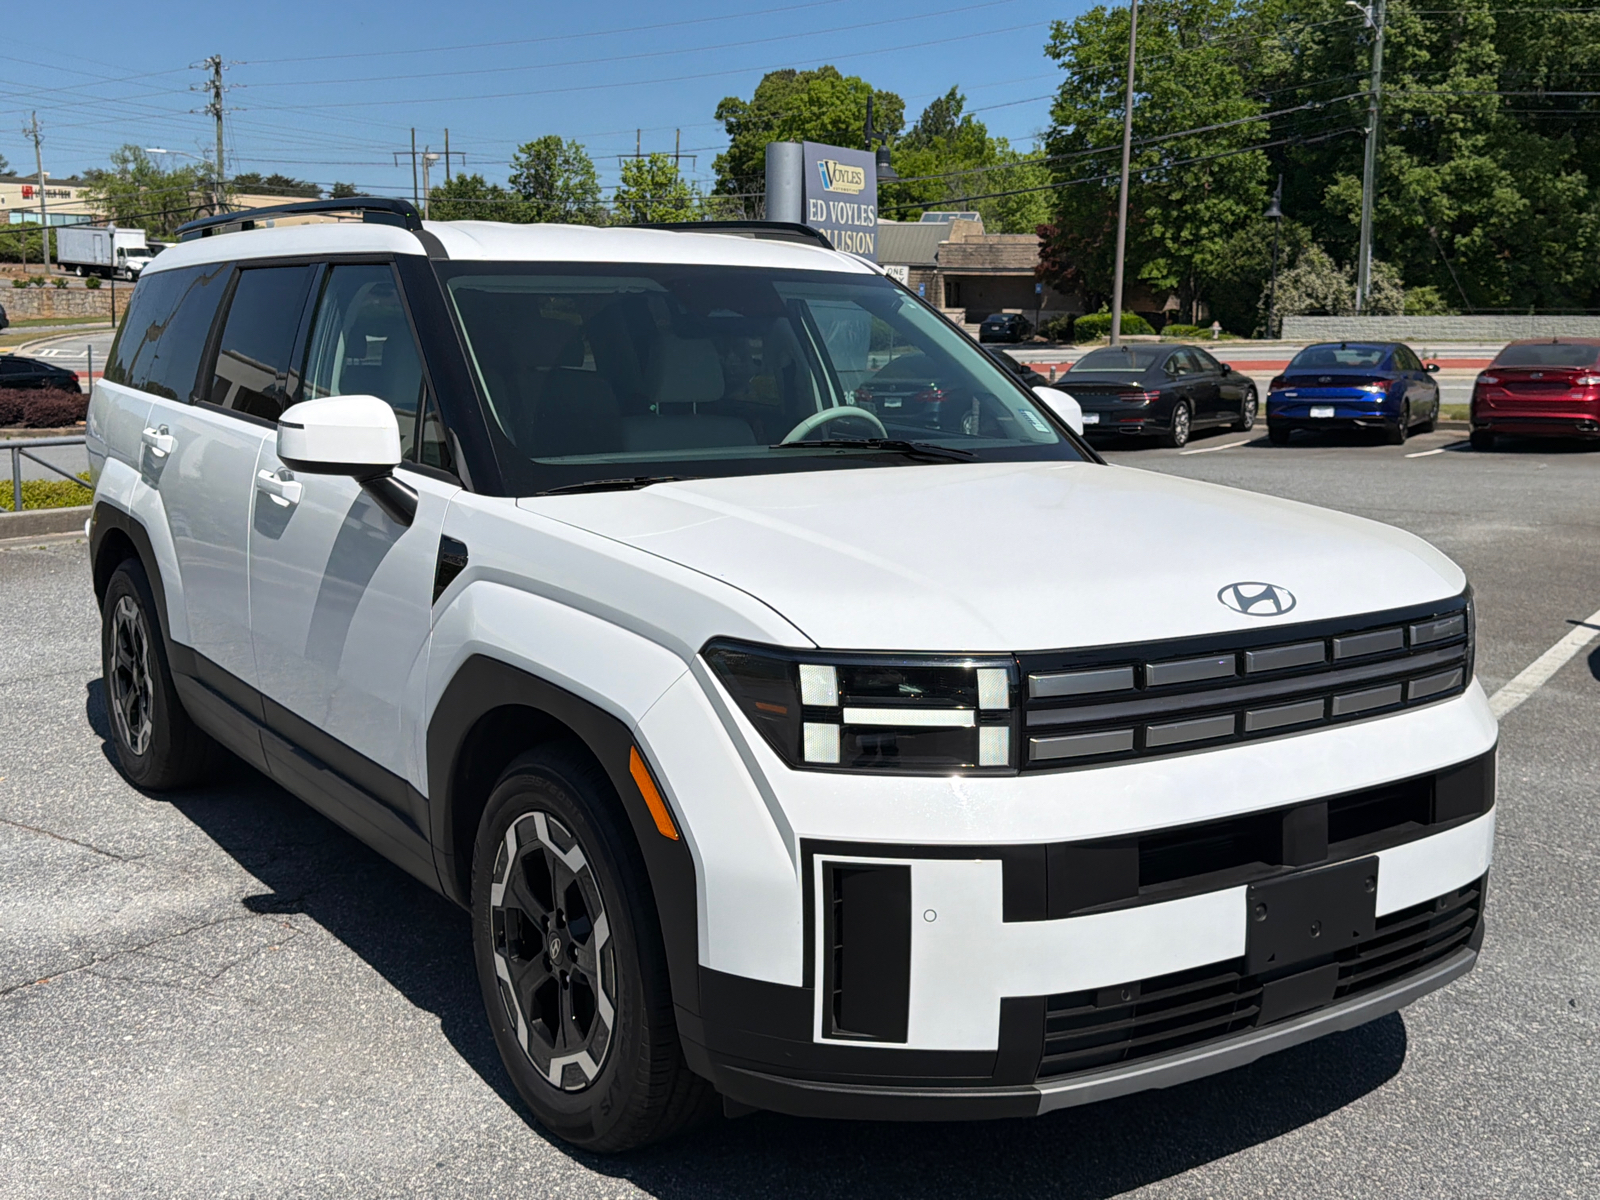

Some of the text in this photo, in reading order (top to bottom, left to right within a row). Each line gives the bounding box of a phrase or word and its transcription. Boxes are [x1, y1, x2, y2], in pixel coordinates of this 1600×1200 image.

[824, 160, 862, 187] VOYLES
[809, 198, 875, 227] ED VOYLES
[818, 228, 875, 255] LISION
[887, 267, 904, 276] ONE
